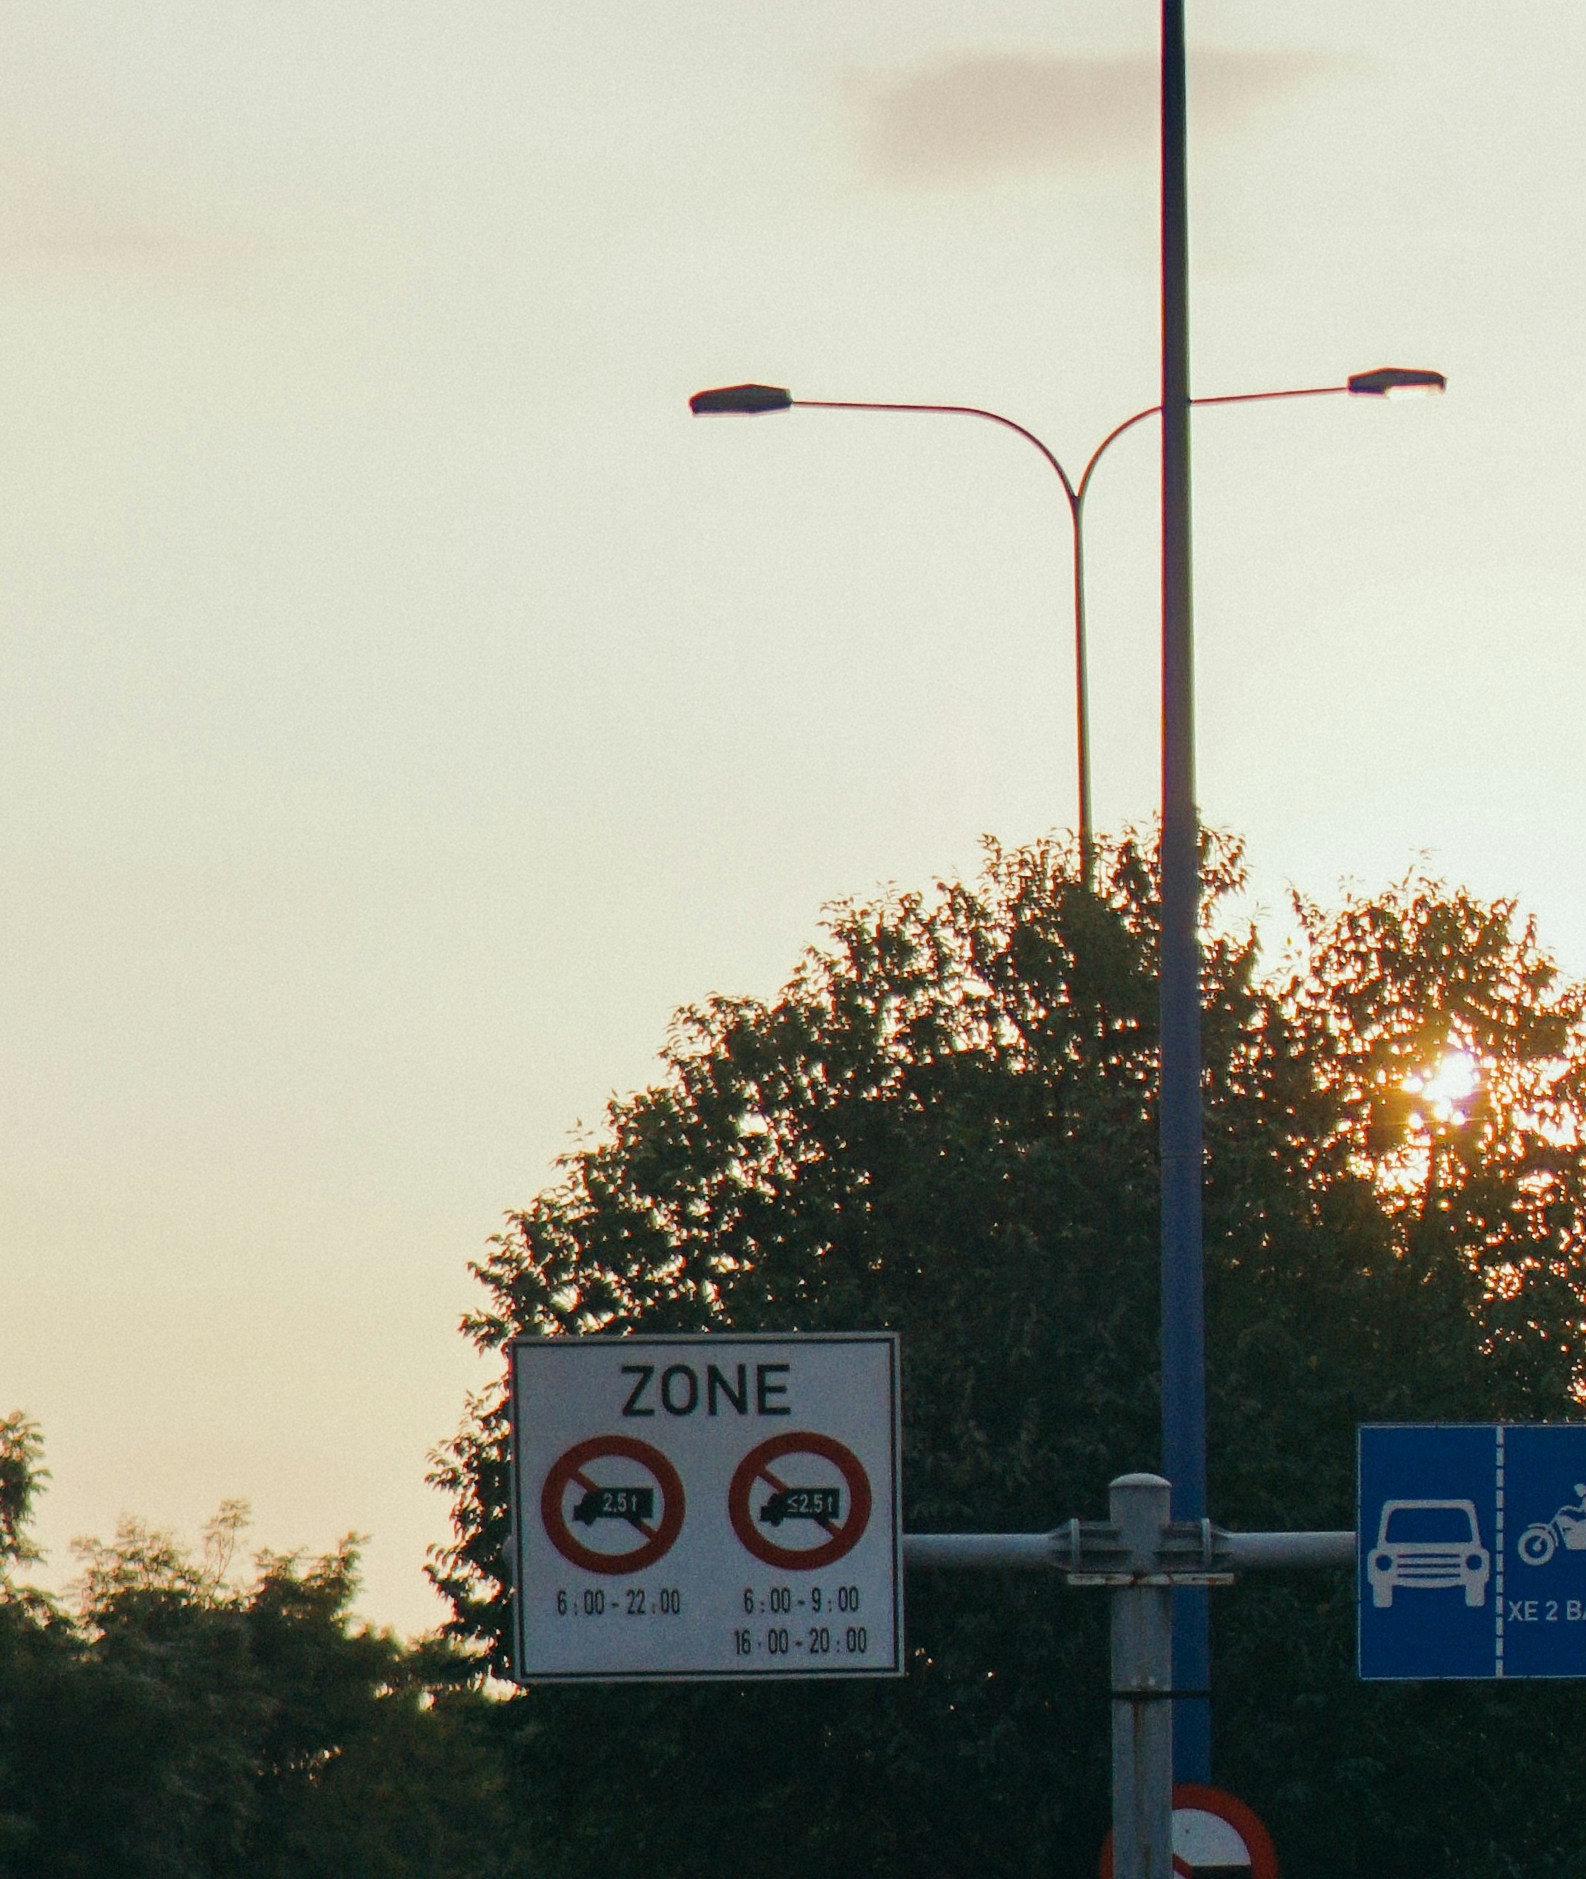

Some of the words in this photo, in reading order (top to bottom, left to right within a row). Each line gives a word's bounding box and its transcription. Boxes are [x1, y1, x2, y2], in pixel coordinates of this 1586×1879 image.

[620, 1363, 791, 1417] ZONE
[1508, 1600, 1539, 1620] XE
[1545, 1600, 1559, 1620] 2
